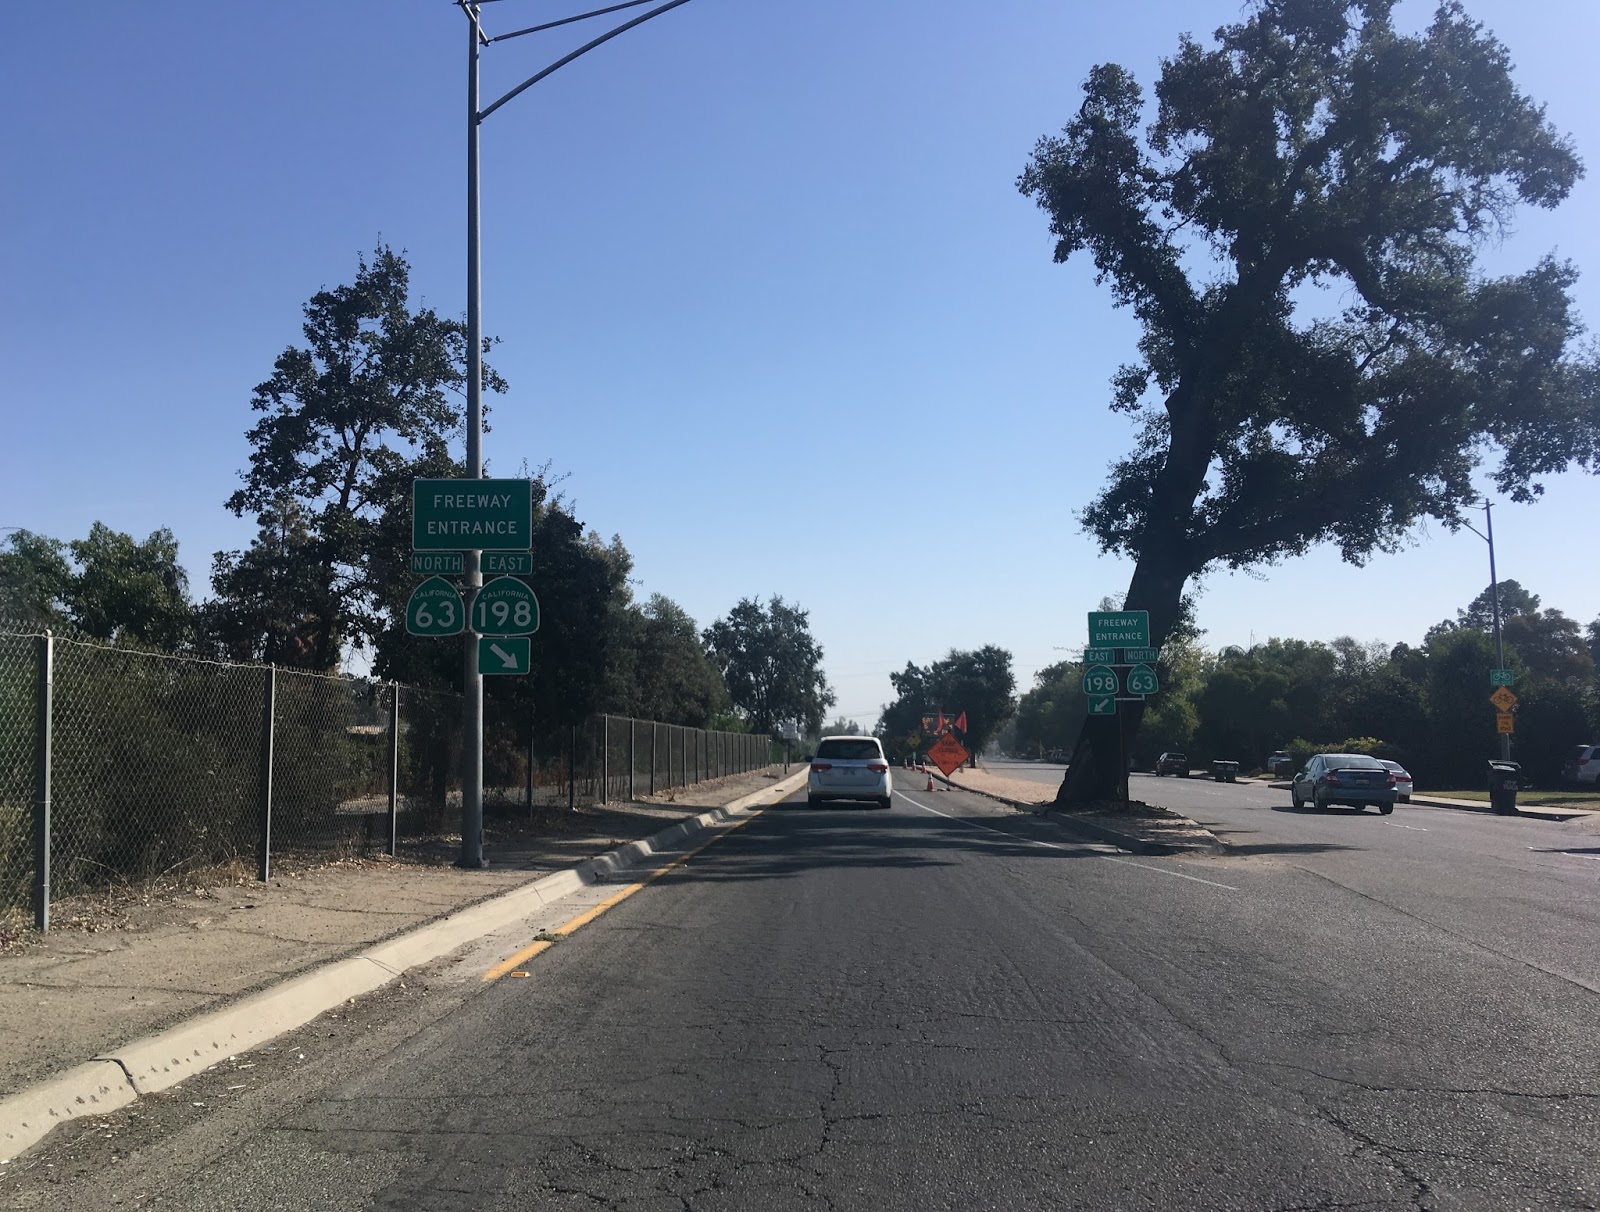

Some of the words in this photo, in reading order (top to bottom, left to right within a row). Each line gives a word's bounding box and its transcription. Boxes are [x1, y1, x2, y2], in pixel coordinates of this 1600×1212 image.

[434, 494, 511, 508] FREEWAY
[427, 520, 517, 535] ENTRANCE
[413, 556, 461, 570] NORTH
[488, 556, 524, 570] EAST
[414, 589, 457, 600] CALIFORNIA
[482, 590, 529, 600] CALIFORNIA
[415, 600, 455, 628] 63
[478, 600, 532, 628] 198
[1098, 619, 1138, 627] FREEWAY
[1095, 632, 1142, 641] ENTRANCE
[1089, 651, 1109, 661] EAST
[1127, 650, 1155, 660] NORTH
[1086, 676, 1115, 691] 198
[1132, 675, 1154, 690] 63
